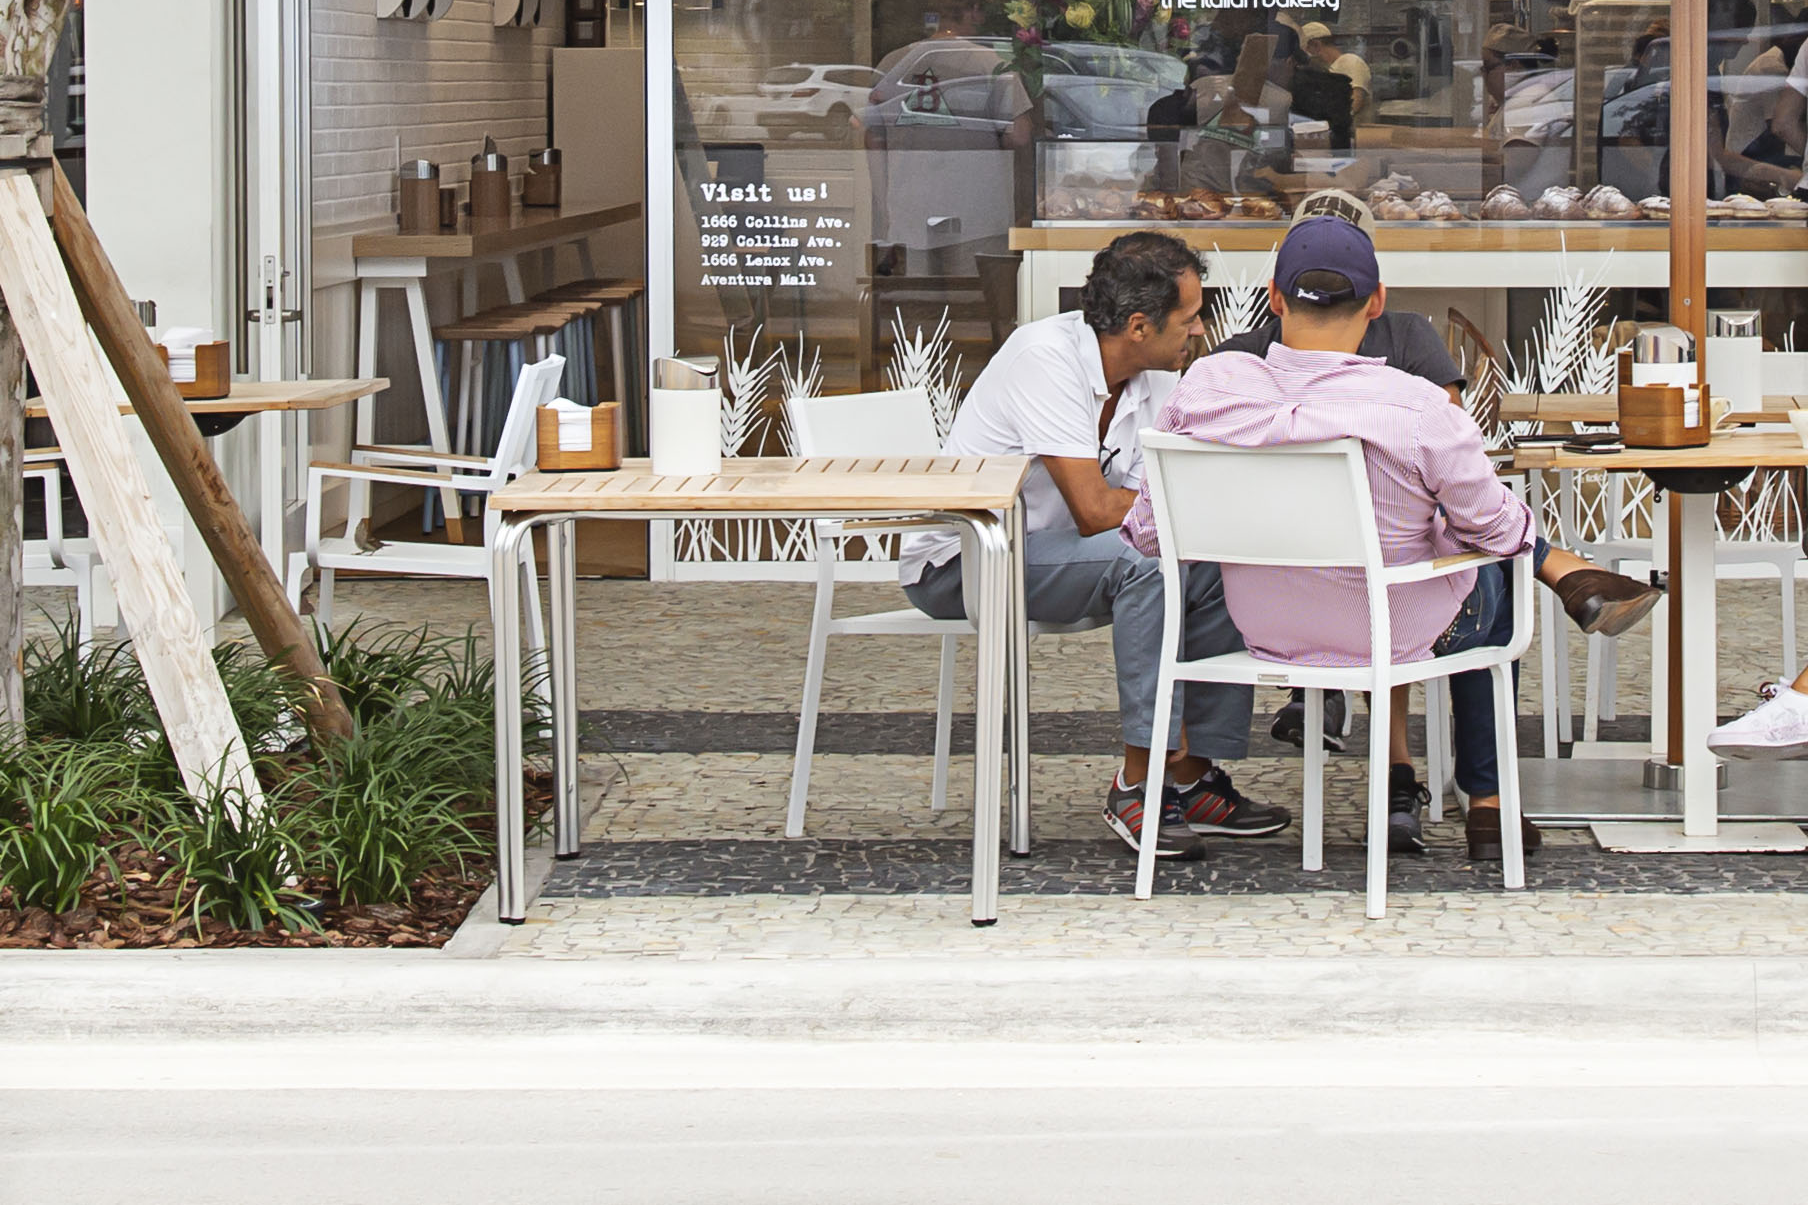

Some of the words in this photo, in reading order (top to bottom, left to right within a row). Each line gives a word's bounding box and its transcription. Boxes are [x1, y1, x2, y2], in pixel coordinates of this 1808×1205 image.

[700, 183, 773, 202] Visit
[786, 182, 828, 202] us!
[701, 214, 738, 228] 1666
[745, 215, 808, 228] Collins
[815, 216, 851, 229] Ave.
[701, 234, 729, 247] 929
[736, 235, 799, 247] Collins
[806, 235, 842, 248] Ave.
[701, 253, 738, 266] 1666
[745, 254, 791, 266] Lenox
[798, 254, 833, 267] Ave.
[701, 273, 772, 286] Aventura
[780, 273, 817, 286] Mall
